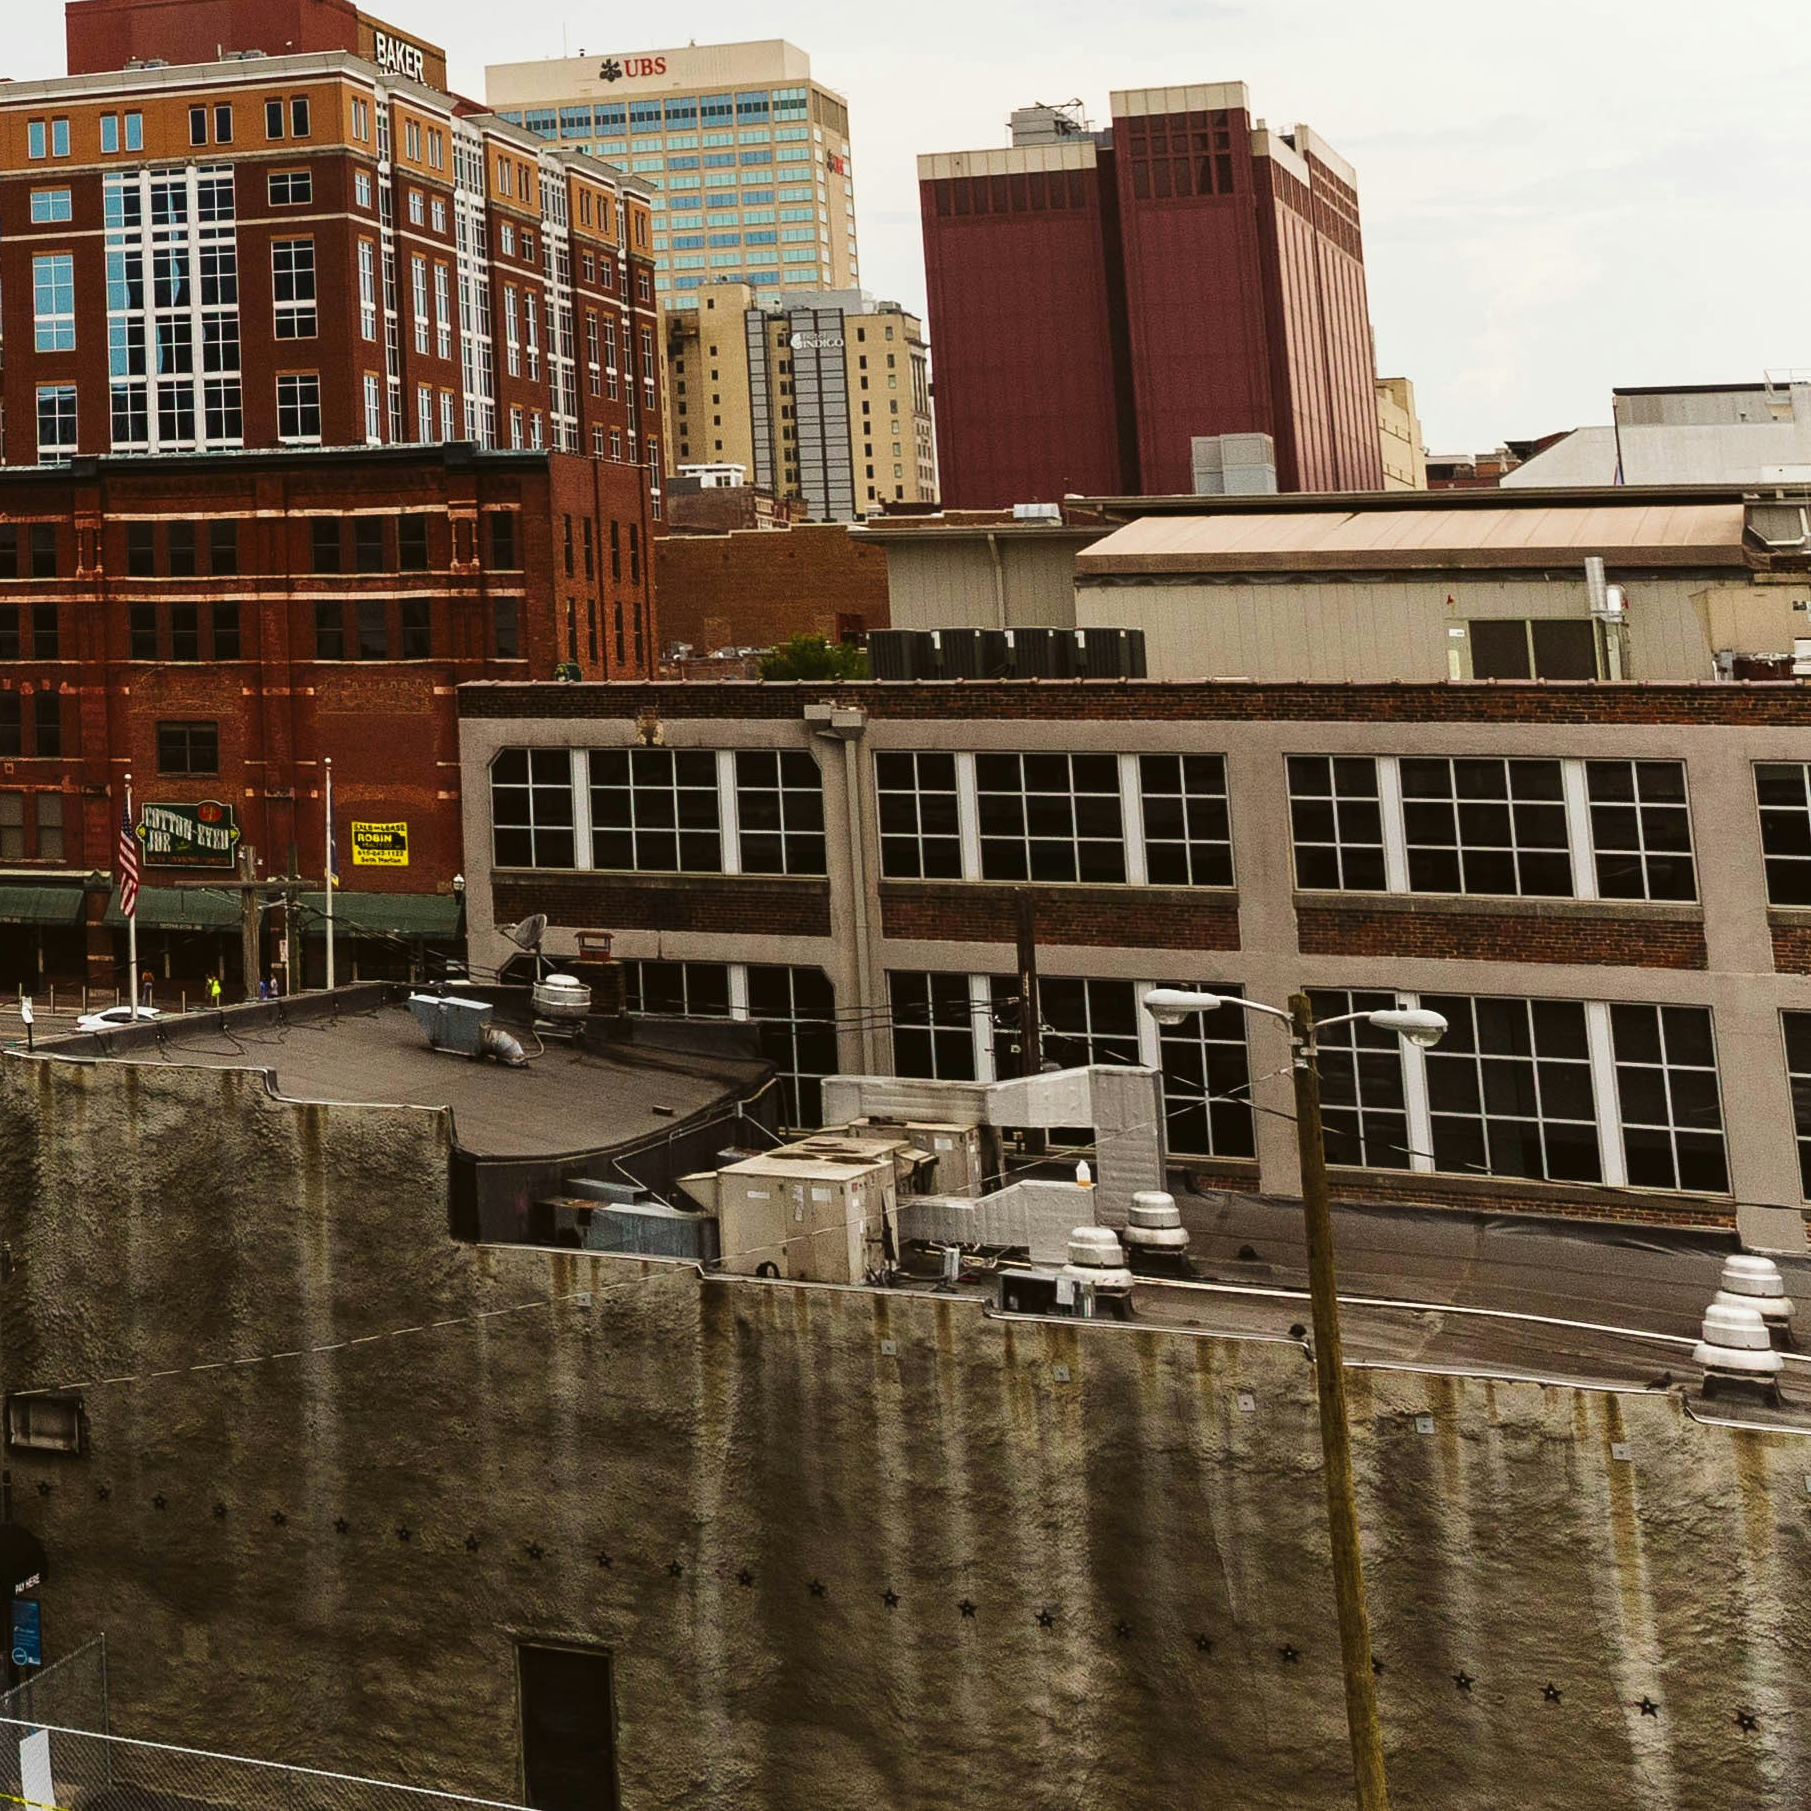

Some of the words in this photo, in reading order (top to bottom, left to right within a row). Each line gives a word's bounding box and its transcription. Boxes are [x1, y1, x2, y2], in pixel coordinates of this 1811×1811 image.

[376, 31, 425, 82] BAKER
[624, 57, 666, 77] UBS
[803, 338, 843, 348] INDIGO
[357, 833, 392, 842] ROBIN
[15, 1583, 25, 1595] PAY
[25, 1573, 40, 1589] HERE
